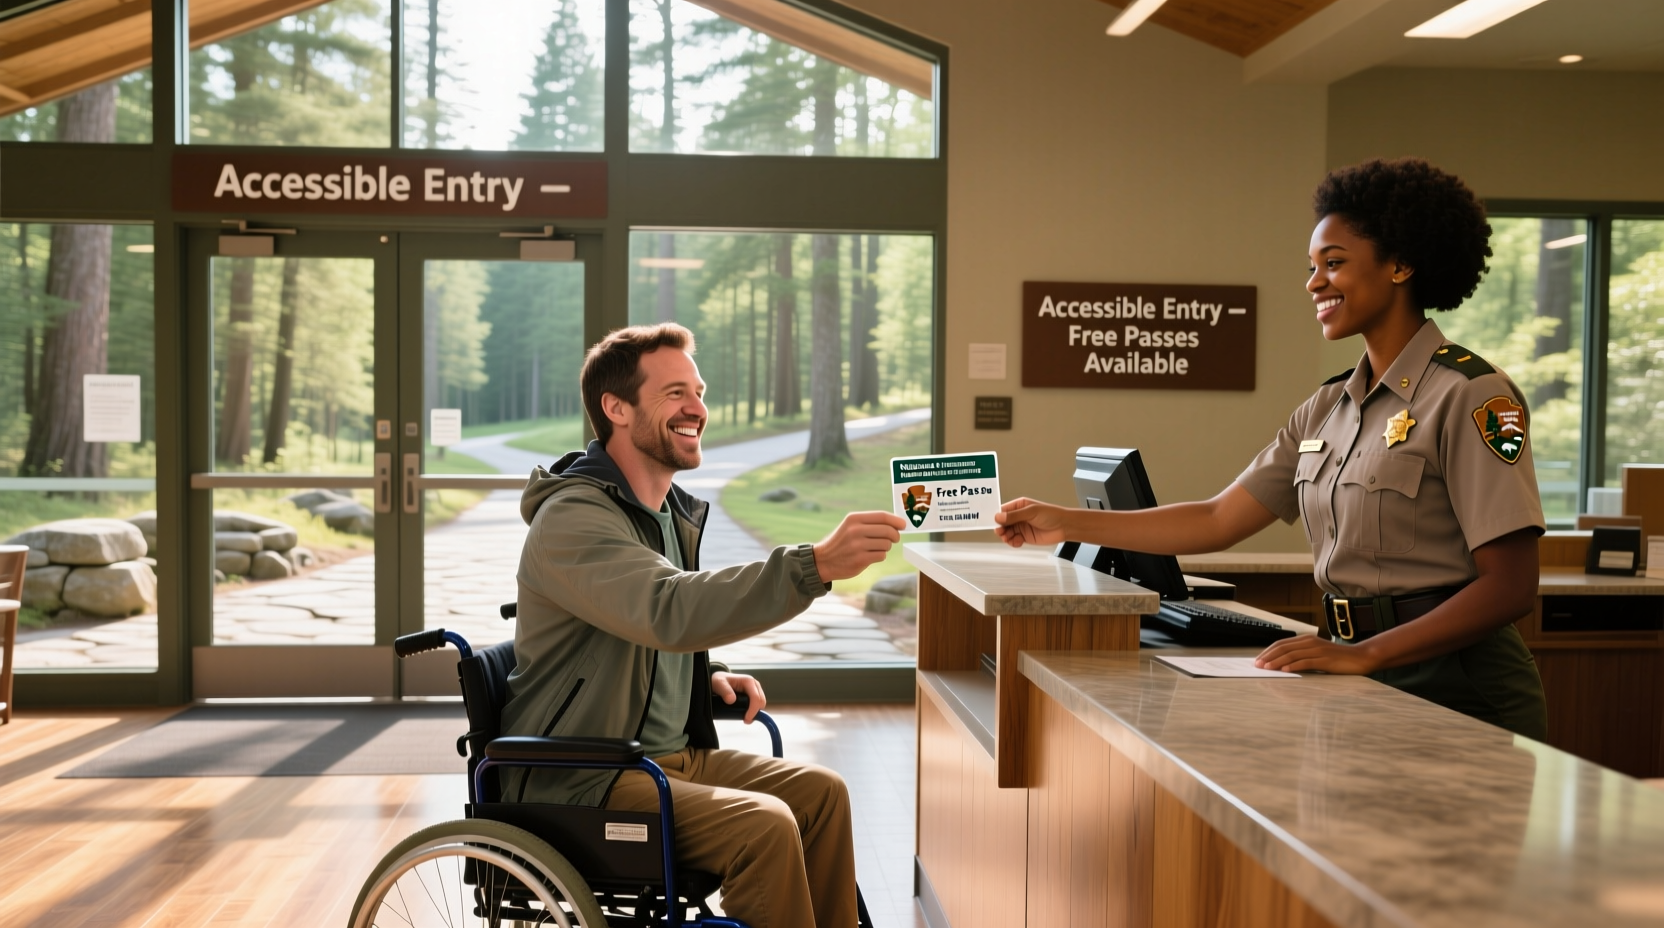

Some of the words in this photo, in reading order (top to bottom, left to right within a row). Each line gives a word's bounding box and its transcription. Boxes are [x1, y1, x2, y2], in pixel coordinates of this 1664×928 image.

[214, 164, 411, 201] Accessible
[425, 168, 524, 211] Entry
[1038, 295, 1156, 319] Accessible
[1164, 298, 1223, 326] Entry
[1069, 326, 1118, 347] Free
[1125, 325, 1199, 347] Passes
[1084, 351, 1189, 375] Available
[936, 487, 958, 498] Free
